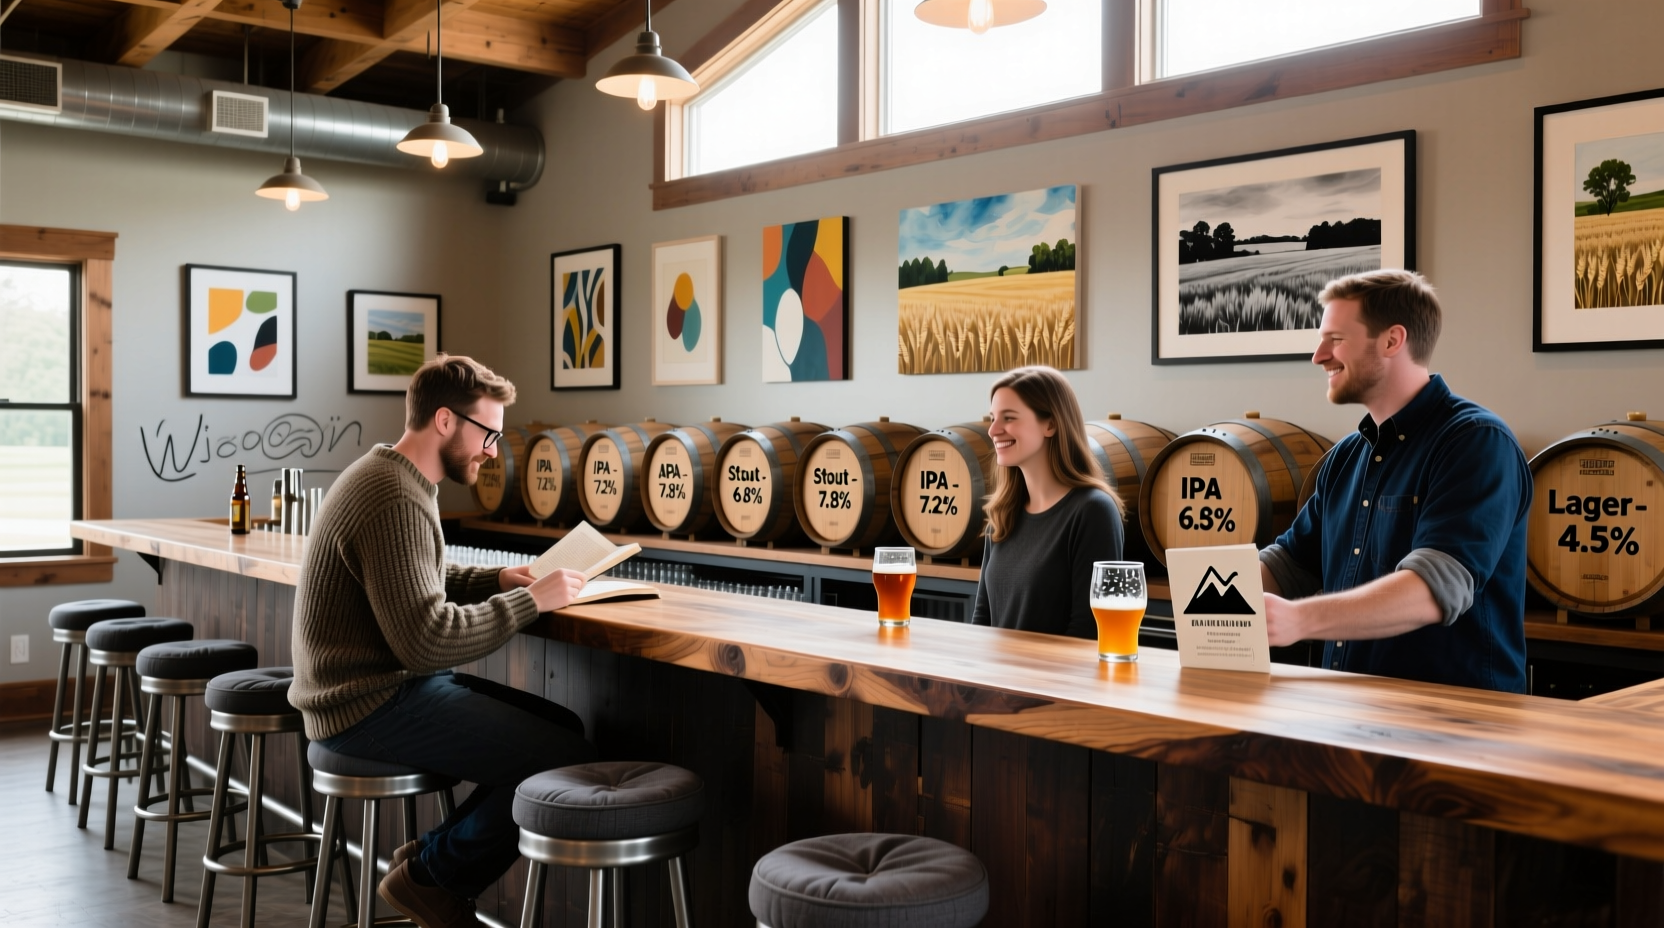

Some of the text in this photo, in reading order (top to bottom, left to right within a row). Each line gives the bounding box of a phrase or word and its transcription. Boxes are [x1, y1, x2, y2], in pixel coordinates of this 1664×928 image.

[593, 460, 611, 475] IPA
[813, 467, 849, 486] Stout
[920, 470, 949, 490] IPA
[1181, 476, 1222, 500] IPA
[658, 483, 686, 500] 7.8%
[818, 490, 852, 509] 7.8%
[919, 495, 958, 515] 7.2%
[1557, 524, 1640, 556] 4.5%
